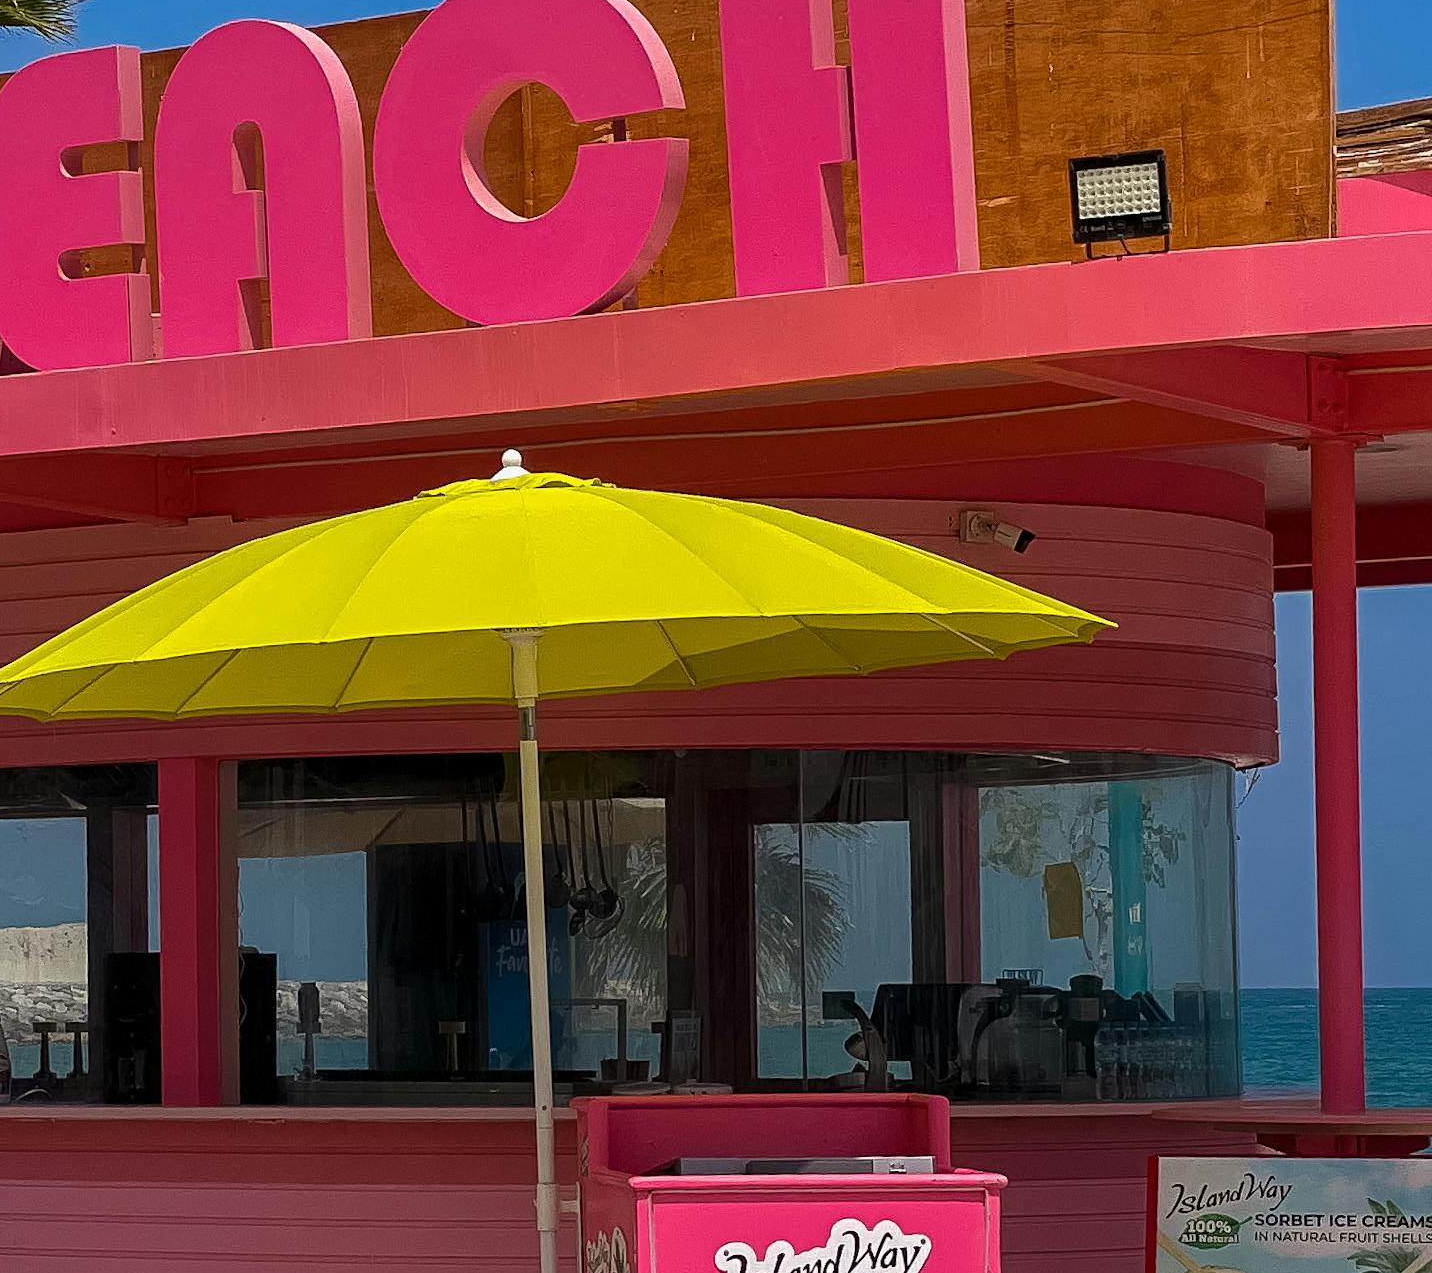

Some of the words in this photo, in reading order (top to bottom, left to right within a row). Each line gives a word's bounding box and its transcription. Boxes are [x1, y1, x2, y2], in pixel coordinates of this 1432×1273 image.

[1166, 1181, 1244, 1219] Island
[1244, 1173, 1293, 1211] Way
[1187, 1220, 1232, 1233] 100%
[1255, 1214, 1324, 1227] SORBET
[1330, 1215, 1356, 1227] ICE
[1362, 1215, 1432, 1228] CREAMS
[1181, 1234, 1197, 1243] All
[1198, 1234, 1239, 1244] Natural
[1255, 1231, 1269, 1241] IN
[1272, 1231, 1336, 1243] NATURAL
[1340, 1232, 1378, 1244] FRUIT
[1382, 1232, 1432, 1244] SHELLS
